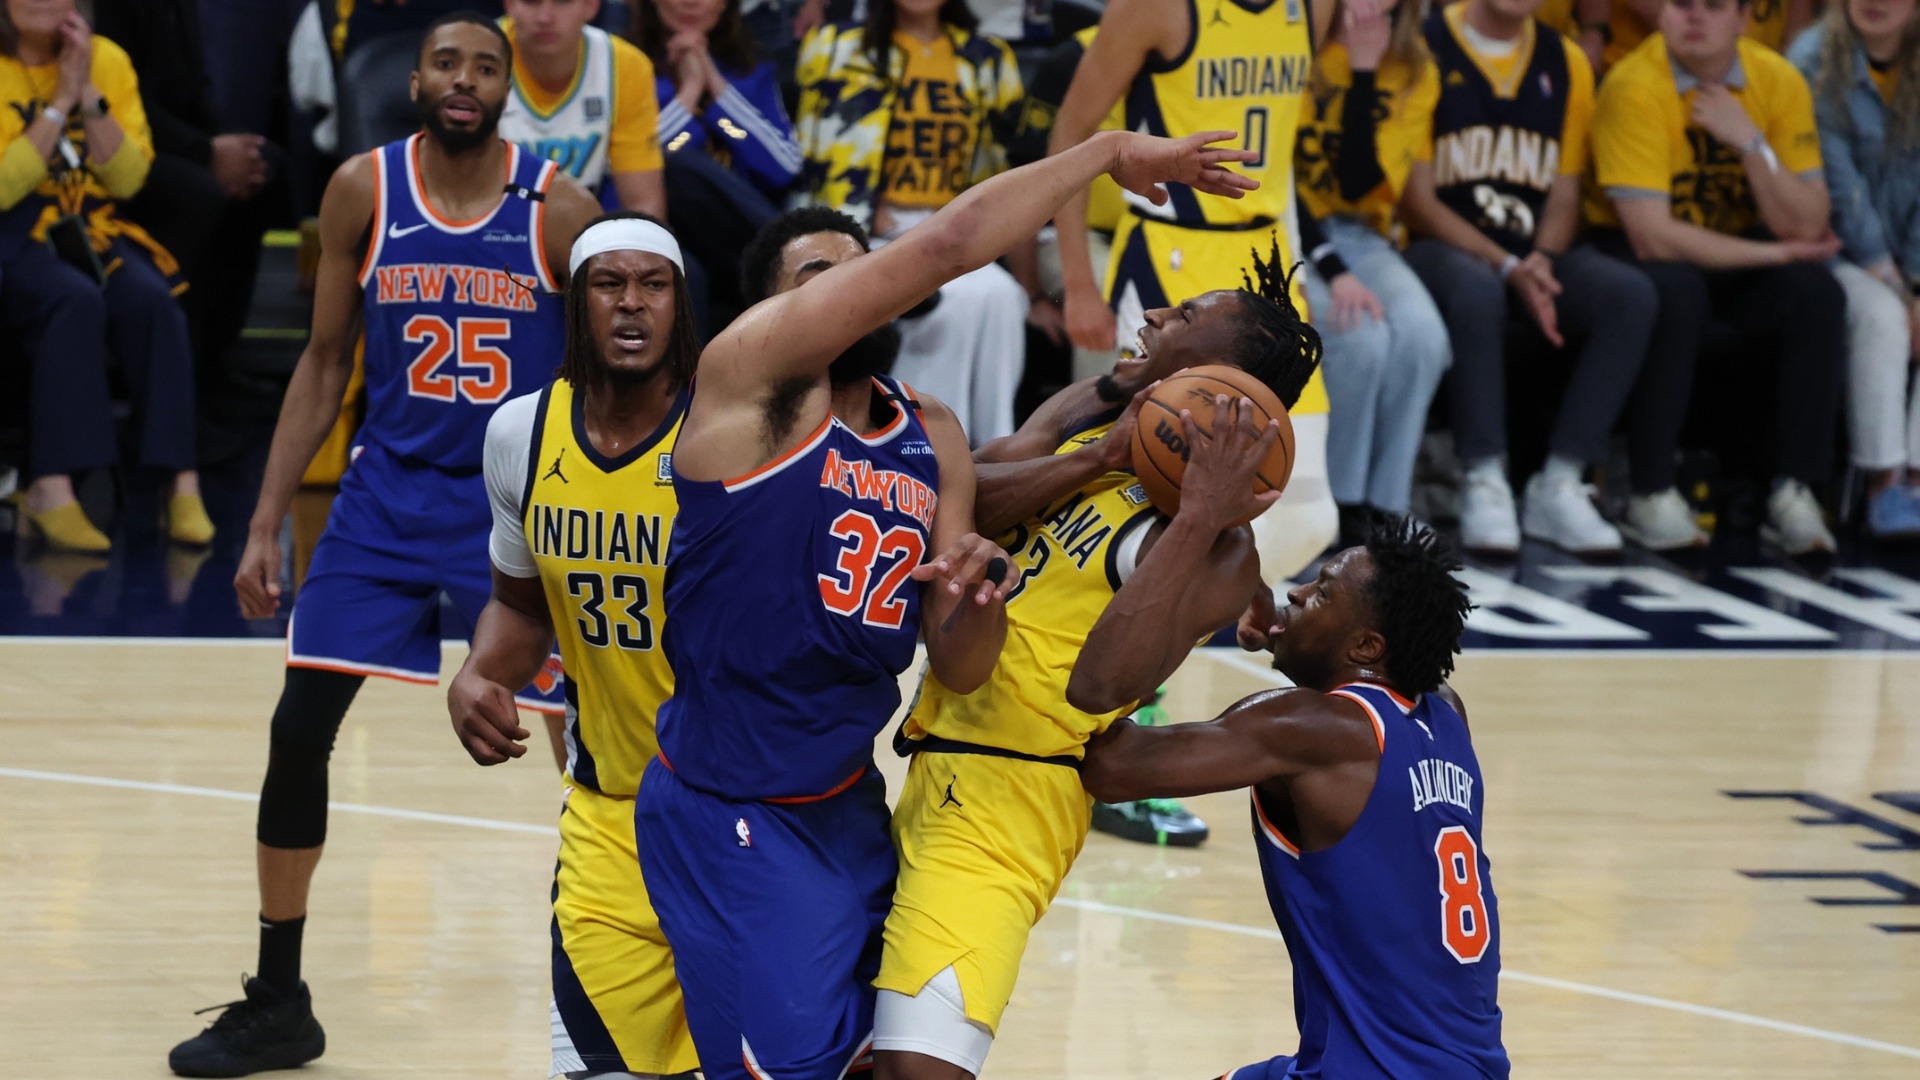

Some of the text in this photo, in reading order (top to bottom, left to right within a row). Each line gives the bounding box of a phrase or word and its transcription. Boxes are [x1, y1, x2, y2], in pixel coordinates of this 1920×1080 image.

[376, 263, 538, 312] NEW YORK
[403, 314, 512, 404] 25
[819, 447, 880, 501] NEW
[566, 571, 654, 651] 33
[817, 508, 926, 630] 32
[1434, 826, 1491, 965] 8
